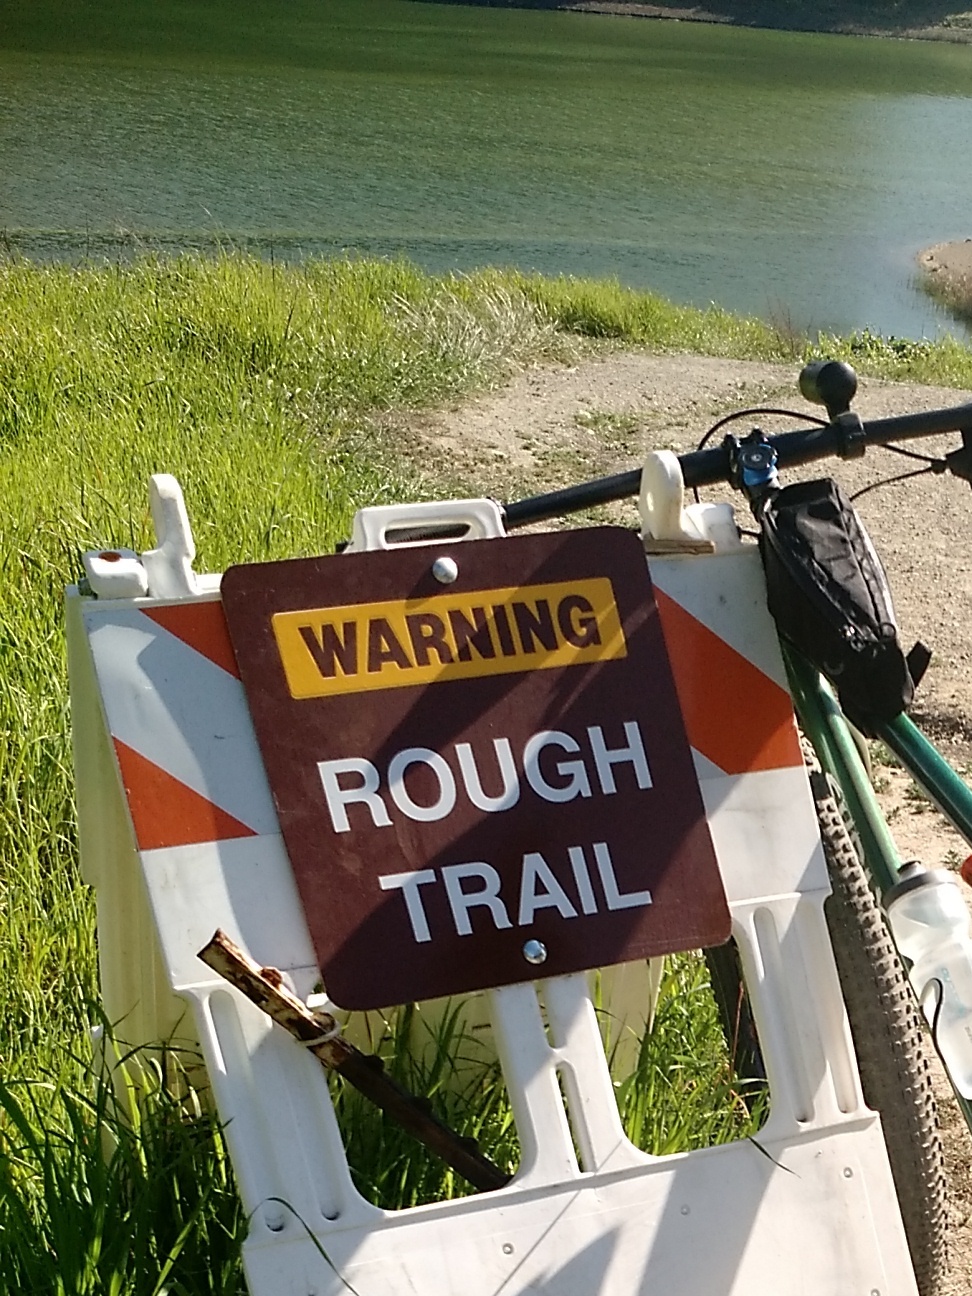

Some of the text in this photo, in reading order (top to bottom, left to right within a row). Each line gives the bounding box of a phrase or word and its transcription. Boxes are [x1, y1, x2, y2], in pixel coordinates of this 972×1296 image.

[298, 594, 602, 680] WARNING
[316, 720, 654, 834] ROUGH
[379, 841, 653, 943] TRAIL
